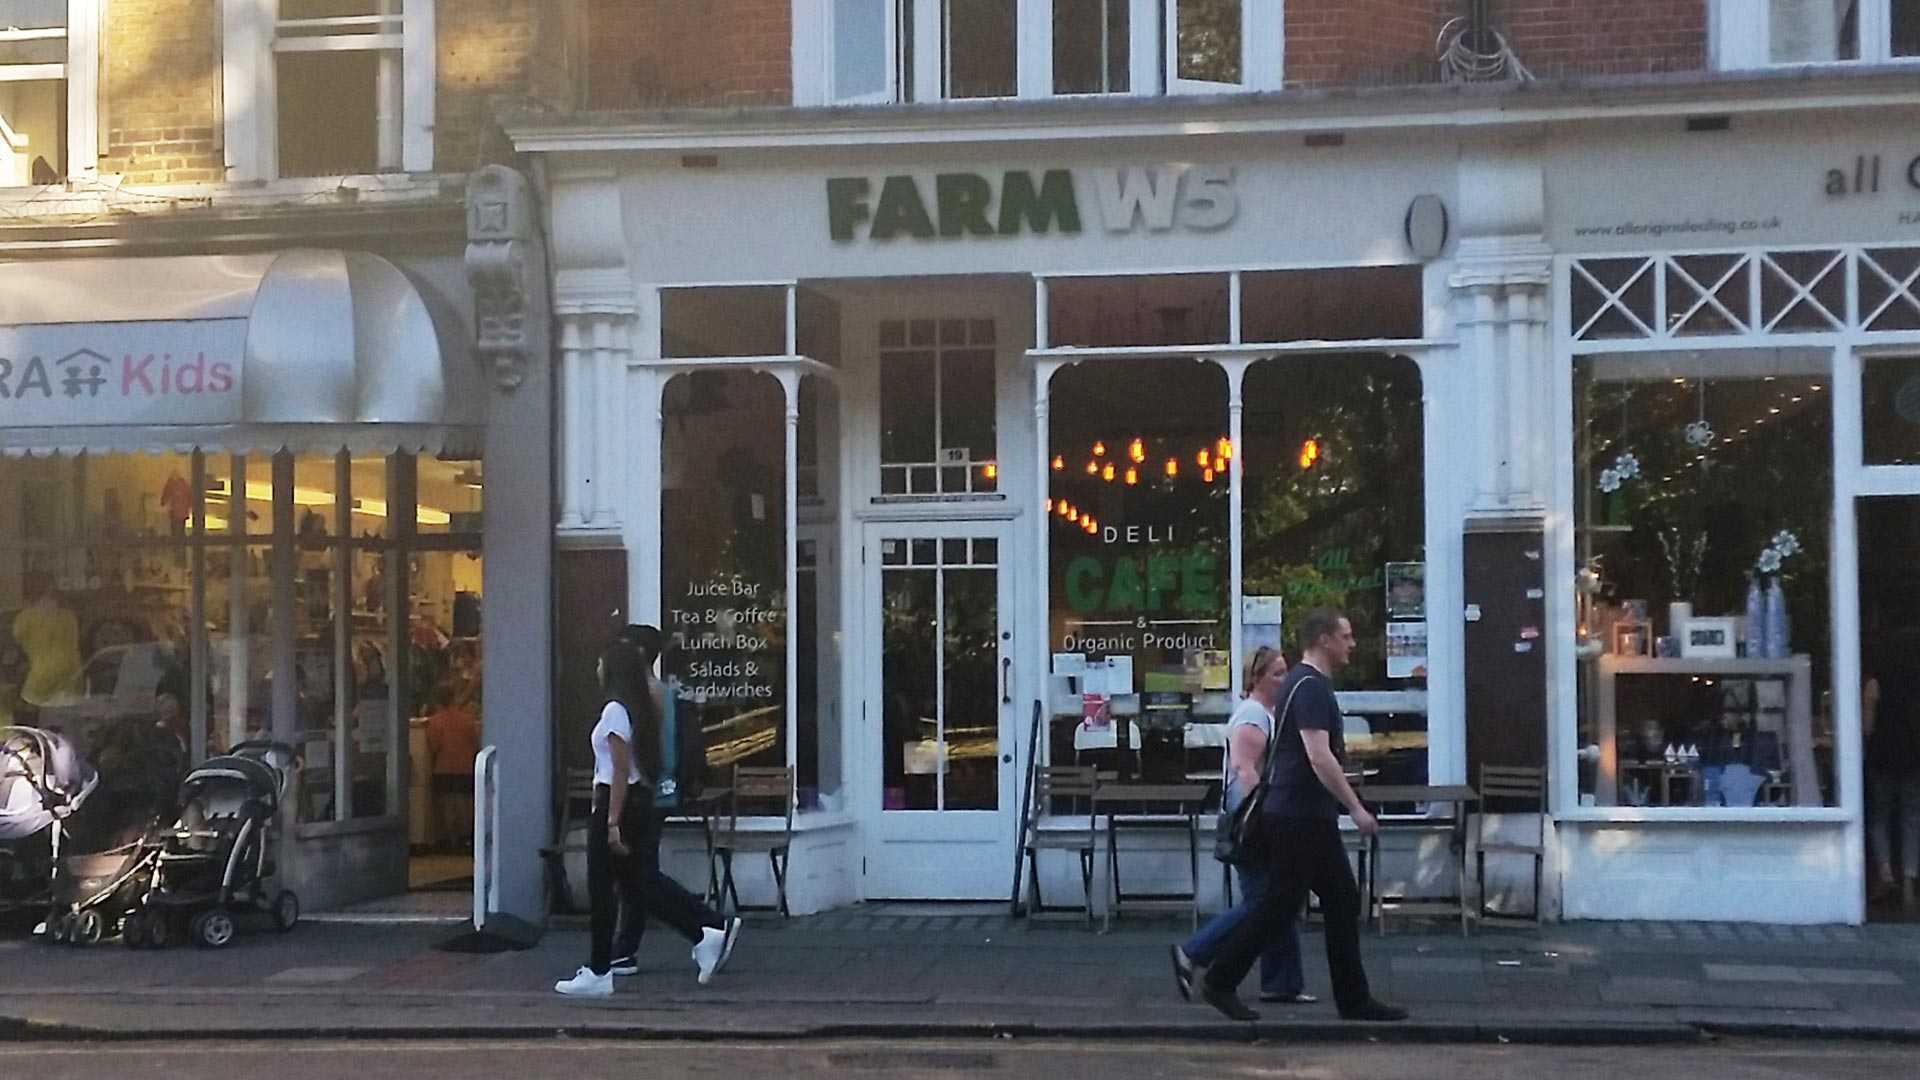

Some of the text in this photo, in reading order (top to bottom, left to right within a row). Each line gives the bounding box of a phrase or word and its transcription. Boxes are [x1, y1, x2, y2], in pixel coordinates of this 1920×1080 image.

[1825, 155, 1880, 195] all
[826, 164, 1241, 241] FARM W5
[120, 351, 233, 396] Kids
[1103, 525, 1174, 544] DELI
[687, 580, 761, 596] Juice Bar
[671, 607, 777, 624] Tea & Coffee
[1136, 616, 1147, 629] &
[681, 633, 768, 650] Lunch Box
[1063, 631, 1216, 654] Organic Product
[690, 660, 759, 678] Salads &
[678, 681, 772, 698] Sandwiches
